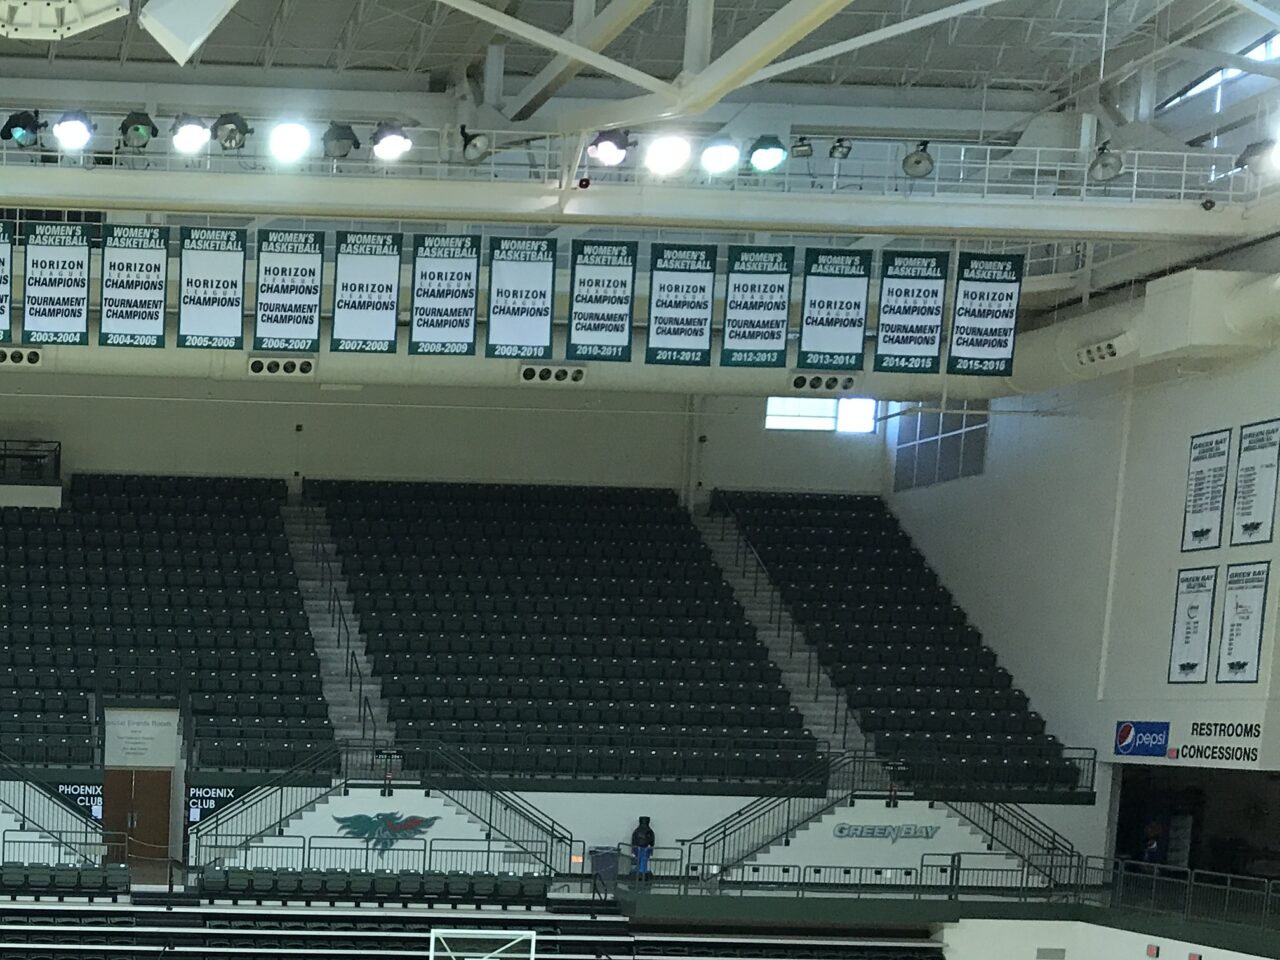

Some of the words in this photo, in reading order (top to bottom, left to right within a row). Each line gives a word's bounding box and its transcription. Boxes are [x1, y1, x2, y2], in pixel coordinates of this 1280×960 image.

[36, 225, 82, 235] WOMEN'S
[113, 228, 159, 238] WOMEN'S
[191, 229, 237, 240] WOMEN'S
[29, 234, 88, 245] BASKETBALL
[107, 237, 165, 249] BASKETBALL
[269, 232, 314, 243] WOMEN'S
[347, 234, 392, 245] WOMEN'S
[425, 237, 471, 247] WOMEN'S
[184, 239, 242, 251] BASKETBALL
[262, 242, 320, 253] BASKETBALL
[340, 243, 398, 255] BASKETBALL
[501, 240, 547, 251] WOMEN'S
[417, 246, 477, 258] BASKETBALL
[494, 250, 553, 261] BASKETBALL
[32, 259, 84, 269] HORIZON
[109, 262, 161, 273] HORIZON
[265, 267, 316, 277] HORIZON
[421, 271, 471, 281] HORIZON
[28, 277, 86, 288] CHAMPIONS
[105, 279, 163, 290] CHAMPIONS
[187, 278, 238, 288] HORIZON
[342, 283, 393, 293] HORIZON
[579, 278, 627, 288] HORIZON
[733, 283, 784, 293] HORIZON
[260, 284, 318, 295] CHAMPIONS
[416, 288, 474, 299] CHAMPIONS
[497, 289, 546, 299] HORIZON
[659, 283, 706, 294] HORIZON
[888, 288, 939, 298] HORIZON
[27, 295, 86, 307] TOURNAMENT
[183, 295, 240, 307] CHAMPIONS
[575, 294, 630, 305] CHAMPIONS
[963, 290, 1013, 301] HORIZON
[104, 298, 163, 309] TOURNAMENT
[259, 302, 318, 313] TOURNAMENT
[337, 300, 395, 311] CHAMPIONS
[656, 299, 708, 310] CHAMPIONS
[810, 300, 861, 309] HORIZON
[29, 307, 82, 318] CHAMPIONS
[106, 309, 159, 320] CHAMPIONS
[414, 307, 474, 318] TOURNAMENT
[492, 305, 549, 317] CHAMPIONS
[261, 313, 314, 325] CHAMPIONS
[416, 318, 470, 328] CHAMPIONS
[727, 319, 785, 330] TOURNAMENT
[805, 316, 863, 327] CHAMPIONS
[881, 324, 940, 334] TOURNAMENT
[30, 332, 80, 343] 2003-2004
[107, 334, 157, 346] 2004-2005
[185, 336, 235, 348] 2005-2006
[262, 339, 312, 350] 2006-2007
[339, 340, 389, 351] 2007-2008
[418, 343, 467, 353] 2008-2009
[1191, 722, 1261, 738] RESTROOMS
[1136, 731, 1166, 748] pepsi
[1181, 745, 1258, 761] CONCESSIONS
[58, 785, 103, 795] PHOENIX
[190, 788, 235, 798] PHOENIX
[77, 797, 103, 806] CLUB
[189, 799, 216, 809] CLUB
